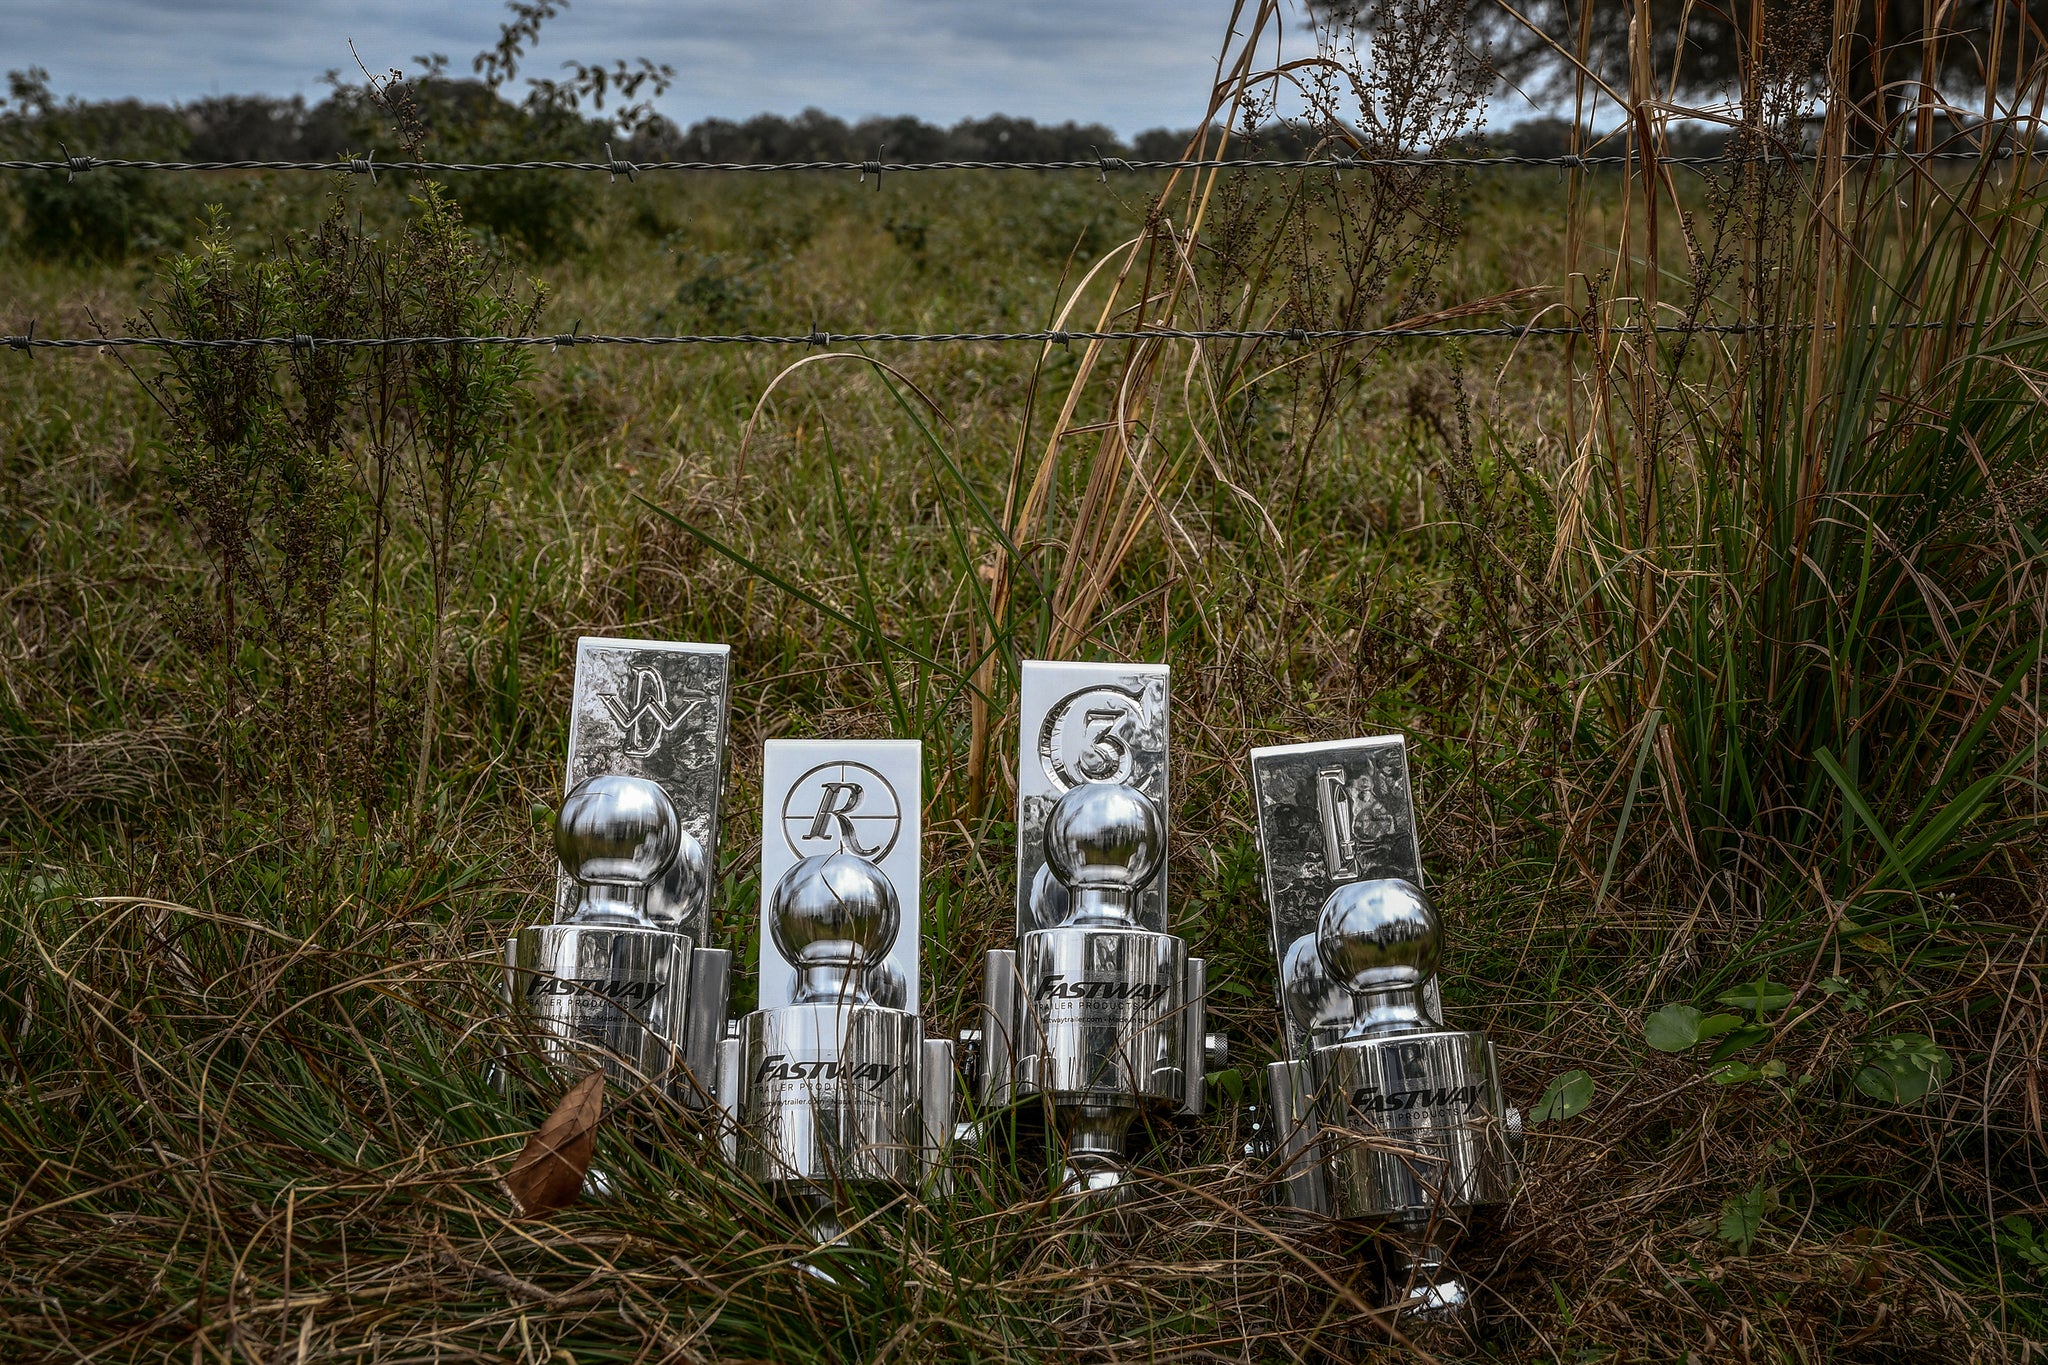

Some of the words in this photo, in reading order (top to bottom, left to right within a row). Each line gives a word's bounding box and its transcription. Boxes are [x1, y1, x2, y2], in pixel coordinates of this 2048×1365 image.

[801, 782, 881, 858] R
[567, 998, 630, 1010] PRODUCS
[1034, 974, 1171, 1011] FASTWAY
[1078, 1001, 1142, 1010] PRODUCTS
[754, 1054, 900, 1092] FASTWAY
[1347, 1085, 1485, 1116] FASTWAY
[1348, 1114, 1393, 1127] TRALER
[1398, 1107, 1459, 1121] PRODUCTS
